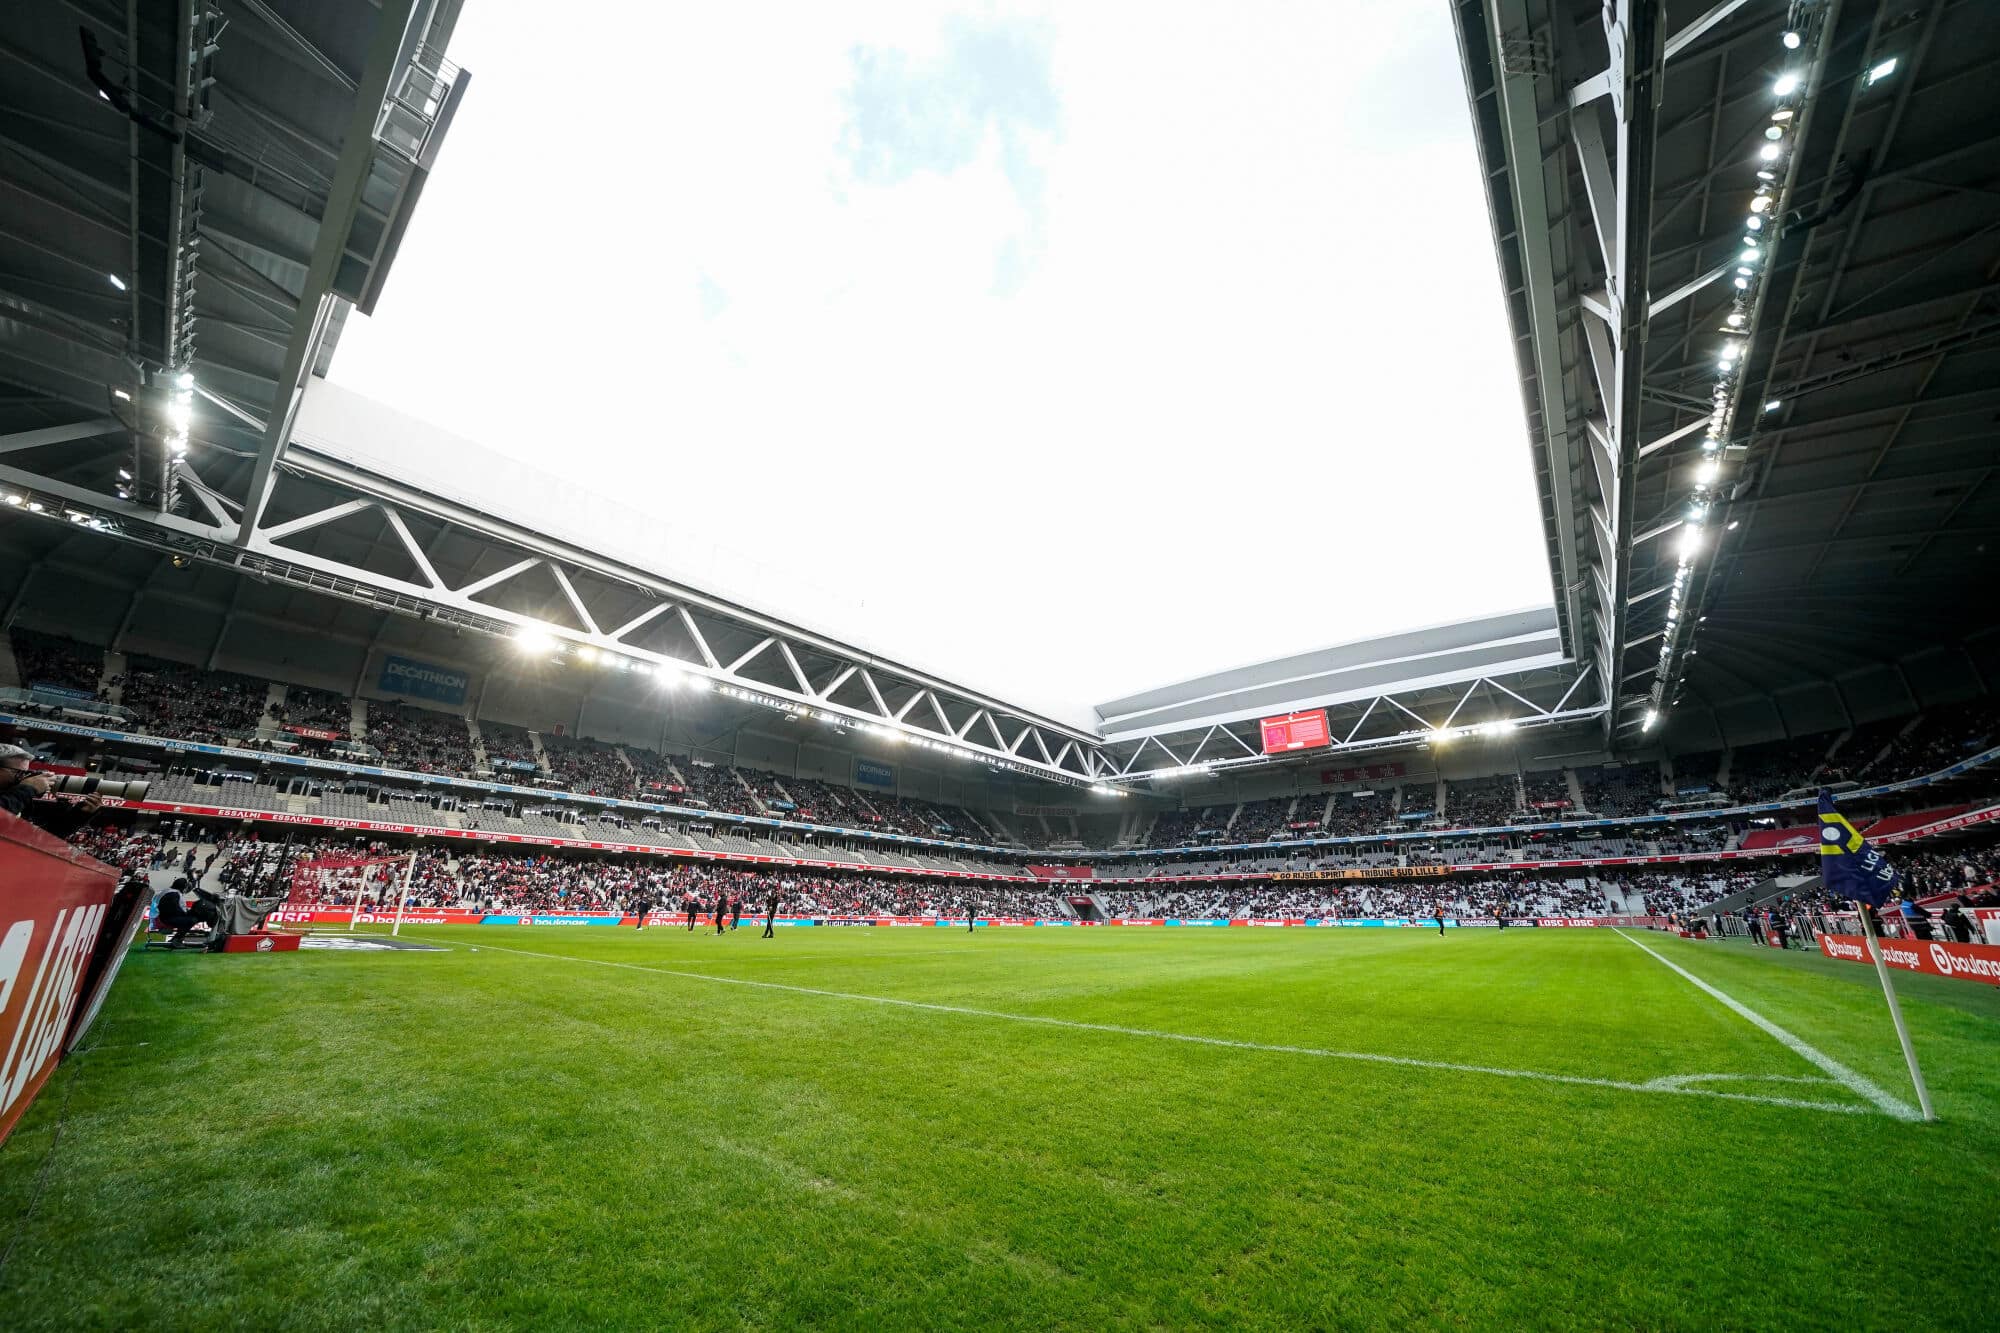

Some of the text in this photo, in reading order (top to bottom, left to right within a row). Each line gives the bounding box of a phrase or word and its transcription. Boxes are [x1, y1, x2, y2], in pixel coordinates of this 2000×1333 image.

[387, 663, 466, 689] DECATHLON
[12, 718, 99, 738] DECATHLON ARENA
[303, 728, 328, 739] LOSC
[167, 741, 200, 751] ARENA
[218, 809, 446, 835] ESSALMI ESSALMI ESSALMI ESSALMI ESSALMI
[1320, 870, 1346, 879] SPIRIT
[1360, 868, 1395, 878] TRIBUNE
[1397, 867, 1413, 877] SUD
[1415, 866, 1438, 876] LILLE
[534, 918, 589, 926] boulanger
[1539, 919, 1563, 927] LOSC
[1568, 919, 1594, 927] LOSC
